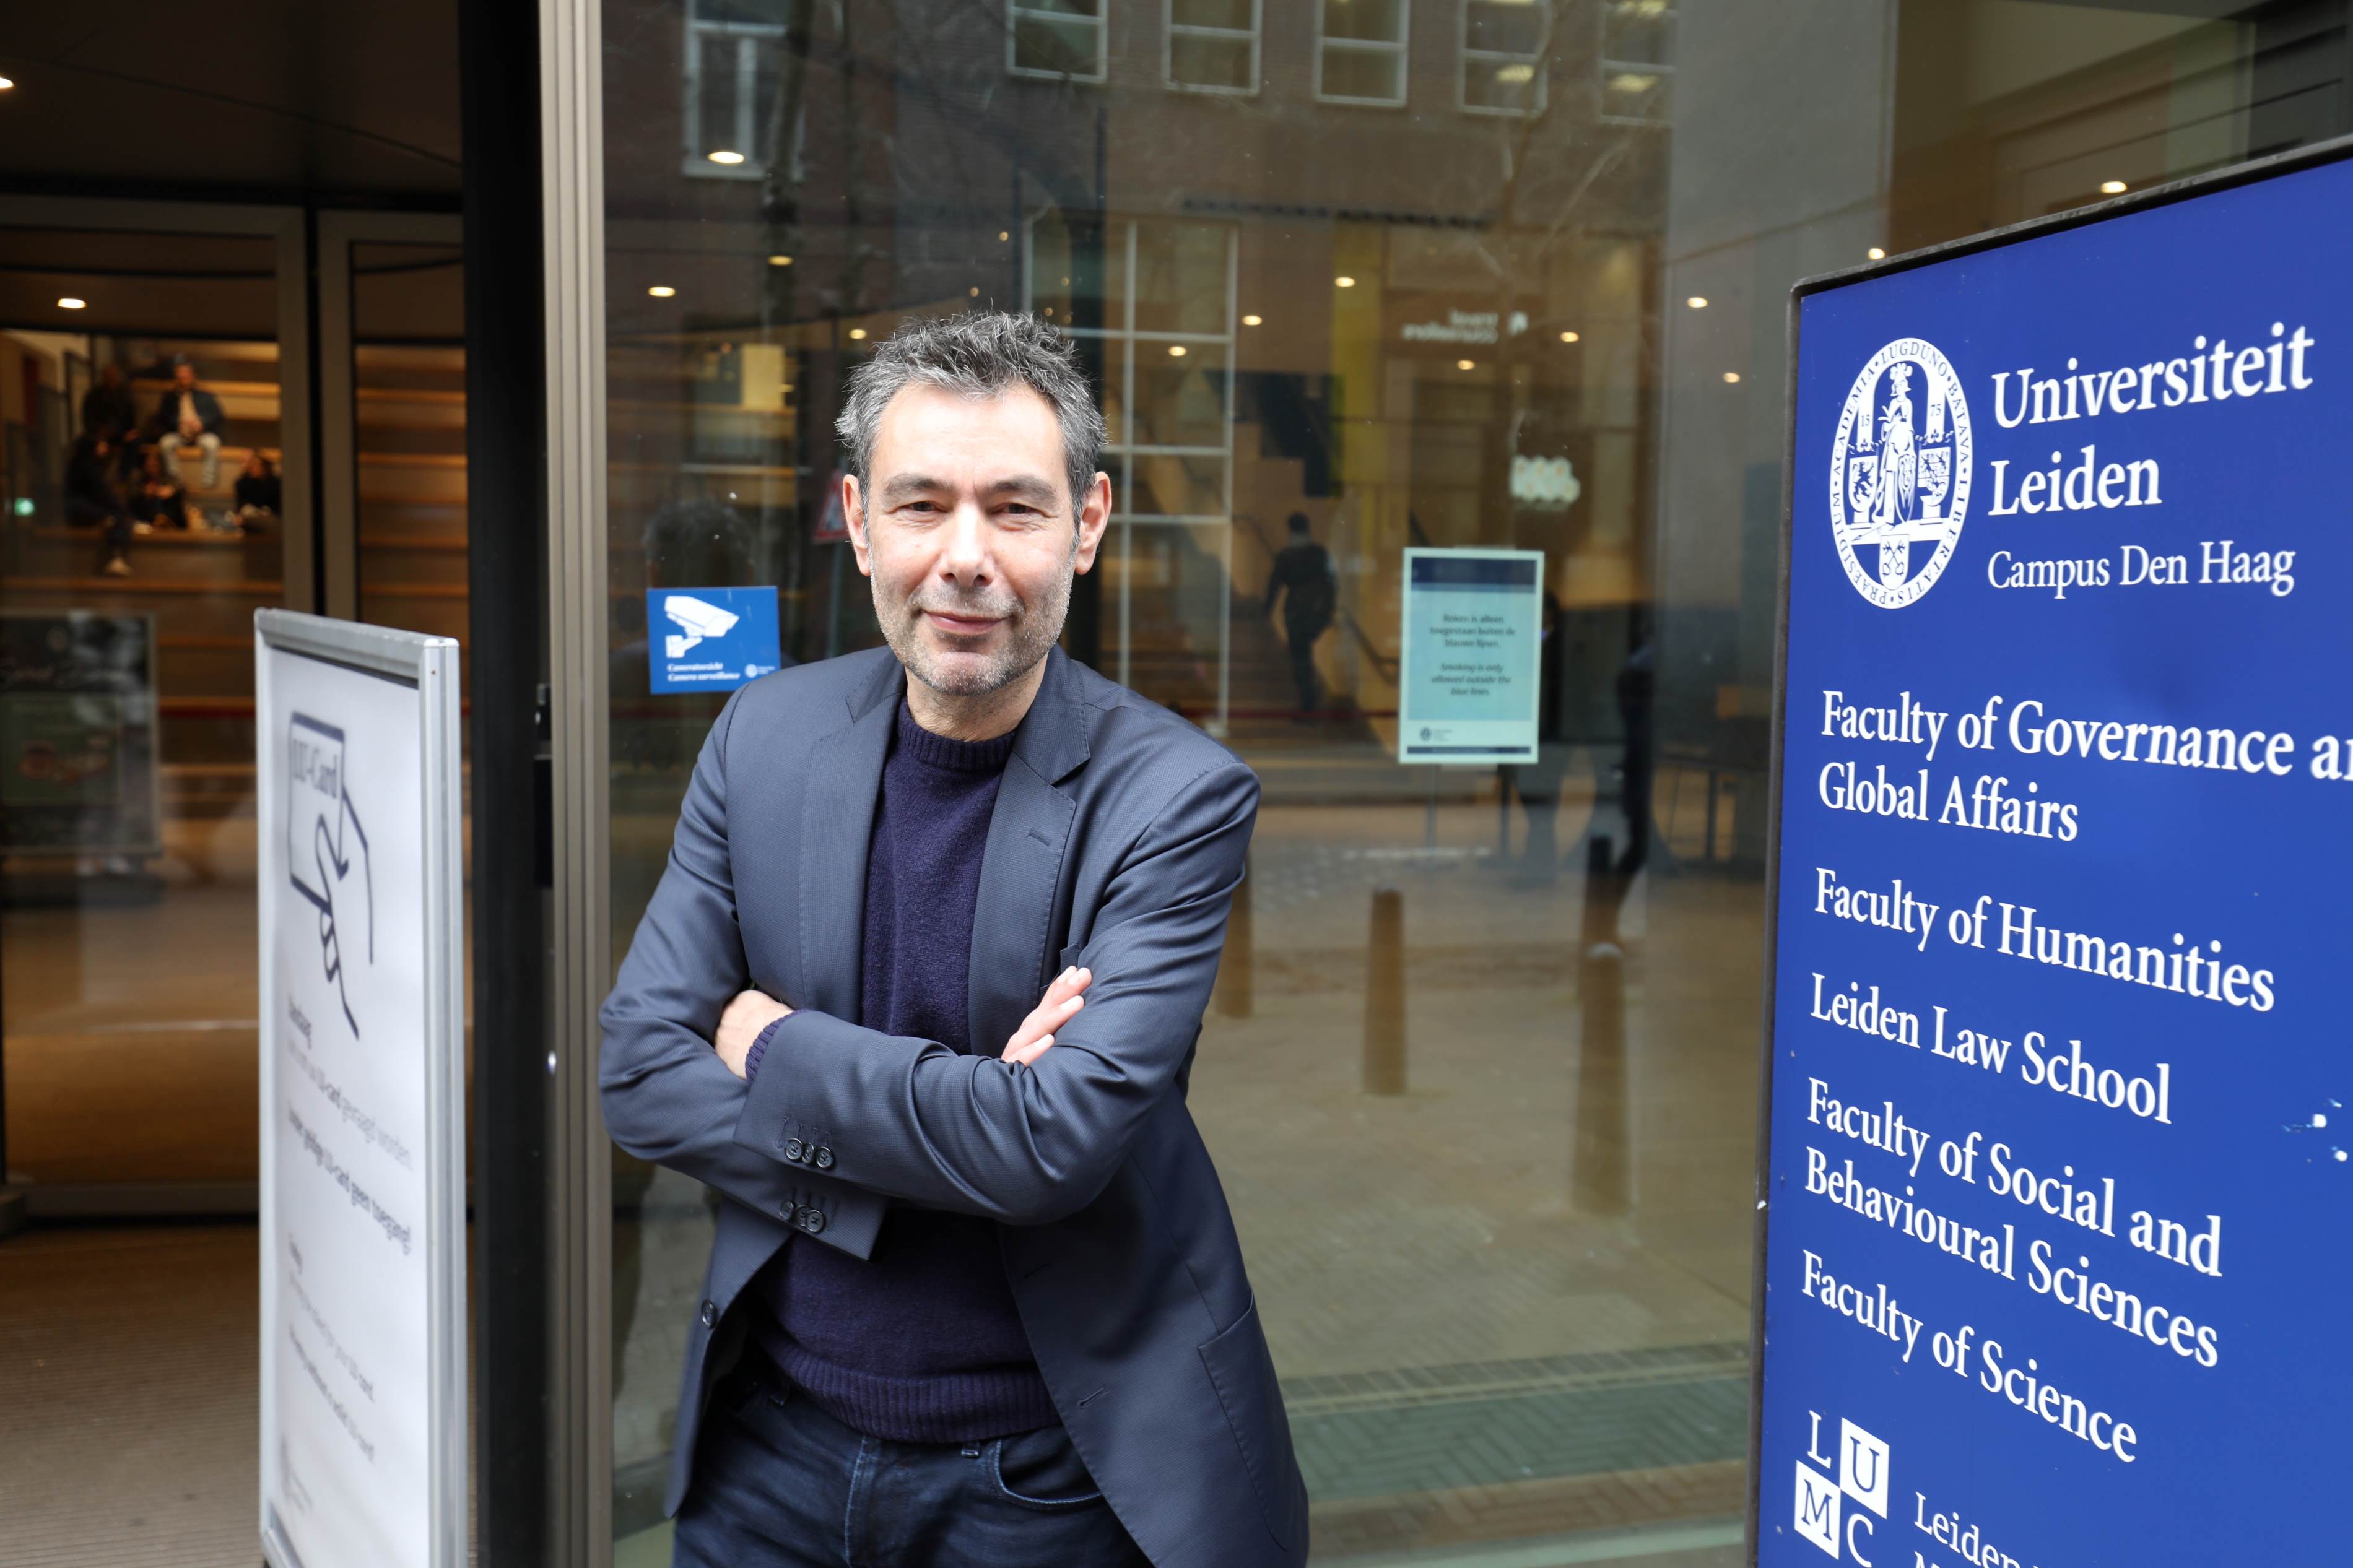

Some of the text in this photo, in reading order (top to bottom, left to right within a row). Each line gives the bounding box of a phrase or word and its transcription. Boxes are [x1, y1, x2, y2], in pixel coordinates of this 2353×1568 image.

[1833, 365, 1876, 475] ACADEMIA
[1880, 340, 1948, 378] LUGDUNO
[1947, 380, 1970, 464] BATAVA
[1860, 413, 1871, 428] 15
[1929, 403, 1942, 417] 75
[1992, 322, 2314, 428] Universiteit
[1988, 444, 2162, 515] Leiden
[1988, 540, 2295, 599] Campus Den Haag
[1822, 691, 1948, 761] Faculty
[1958, 696, 2003, 749] of
[2009, 701, 2294, 775] Governance
[1820, 761, 2077, 841] Global Affairs
[1815, 868, 2274, 1011] Faculty of Humanities
[1811, 973, 2171, 1124] Leiden Law School
[1808, 1077, 2222, 1276] Faculty of Social and
[1806, 1146, 2217, 1367] Behavioural Sciences
[1802, 1250, 2136, 1462] Faculty of Science
